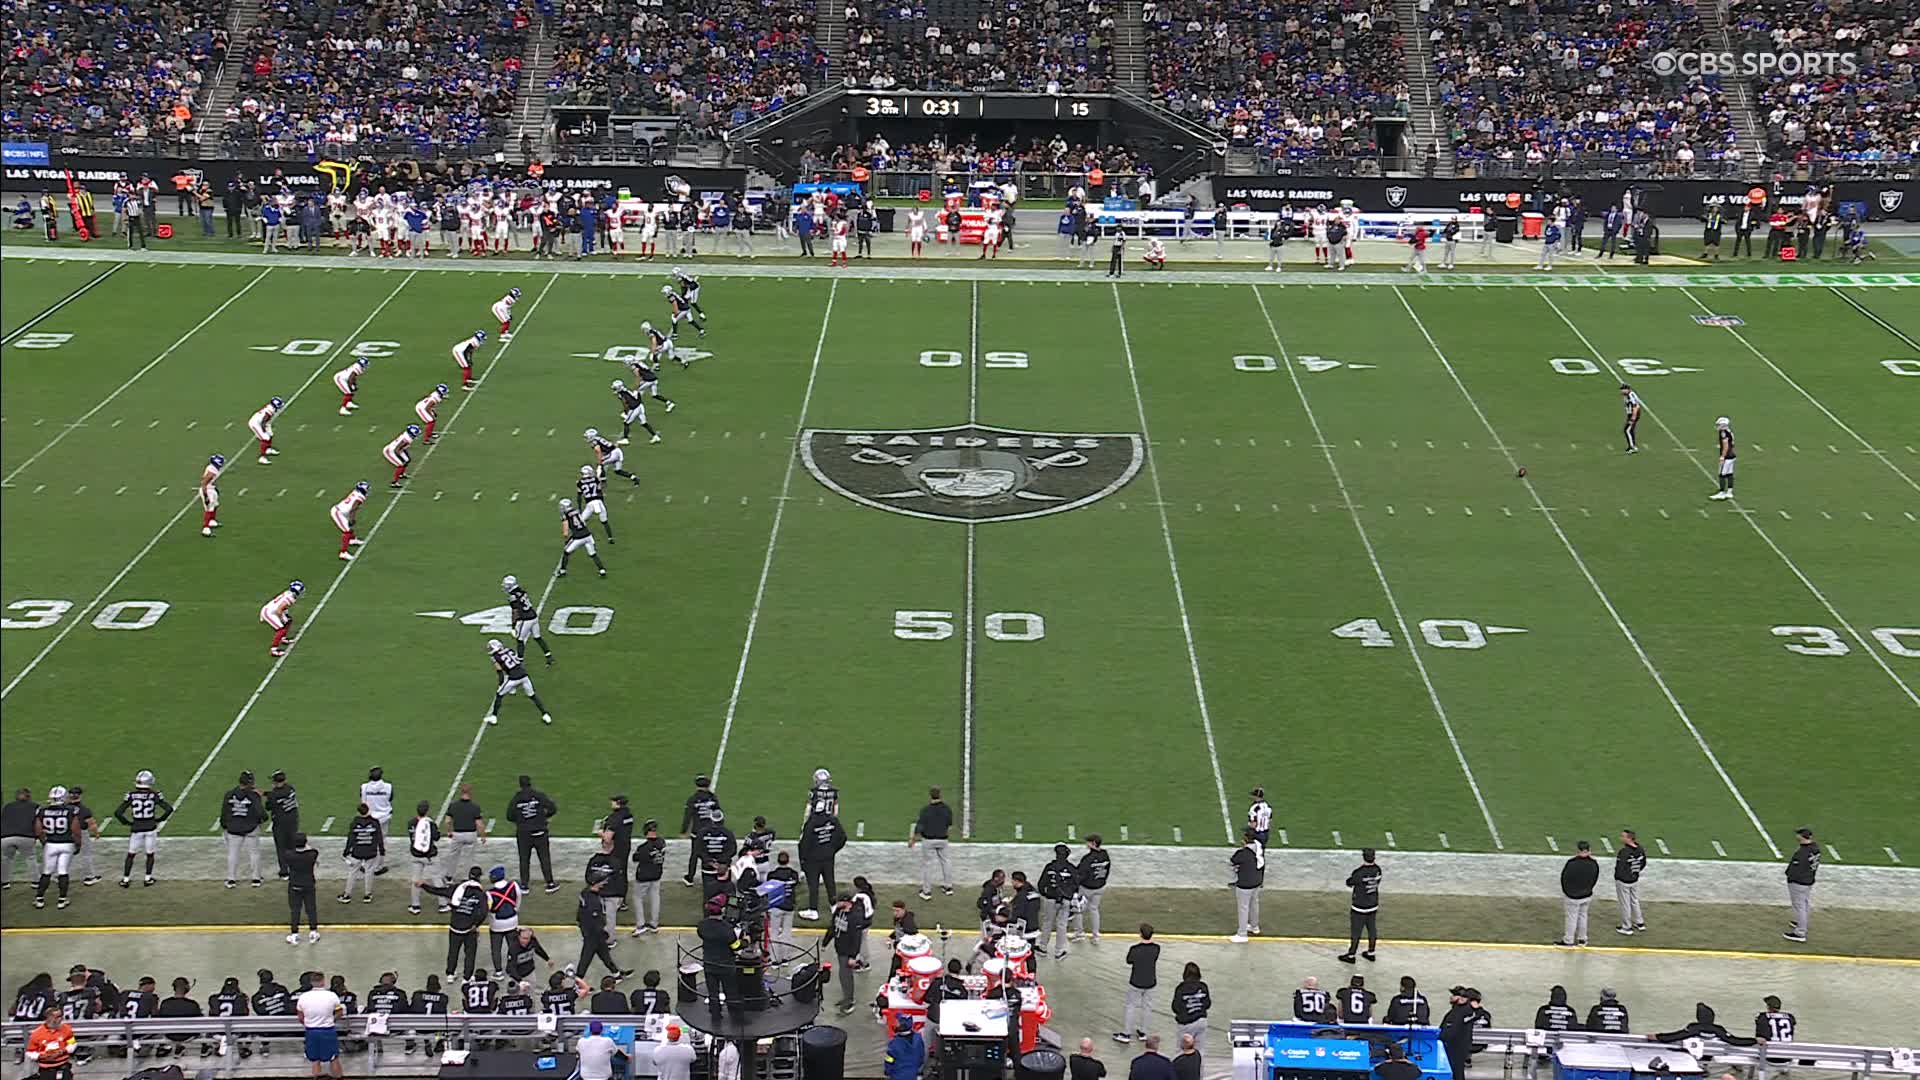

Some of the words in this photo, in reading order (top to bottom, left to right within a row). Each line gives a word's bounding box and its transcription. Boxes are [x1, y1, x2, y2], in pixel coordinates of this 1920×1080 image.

[867, 98, 880, 115] 3
[922, 99, 960, 115] 0:31
[1071, 102, 1090, 116] 15
[6, 169, 30, 178] LAS
[78, 171, 120, 181] RAIDER
[1227, 189, 1247, 197] LAS
[1250, 190, 1284, 199] VEGAS
[1289, 191, 1333, 200] RAIDERS
[1460, 193, 1481, 202] LAS
[1703, 196, 1725, 204] LAS
[281, 340, 400, 357] 30
[920, 350, 1029, 369] 50
[1232, 354, 1343, 373] 40
[1549, 356, 1672, 376] 30
[844, 434, 1101, 450] RAIDERS
[581, 483, 598, 498] 27
[0, 599, 170, 630] 30
[893, 610, 1045, 642] 50
[1330, 616, 1489, 650] 40
[132, 800, 155, 818] 22
[43, 817, 68, 834] 99
[919, 979, 930, 990] G
[468, 986, 489, 1008] 81
[1302, 993, 1325, 1013] 50
[1351, 992, 1364, 1013] 6
[126, 1001, 139, 1020] 3
[425, 1002, 433, 1015] 1
[644, 998, 656, 1015] 7
[1768, 1019, 1792, 1042] 12
